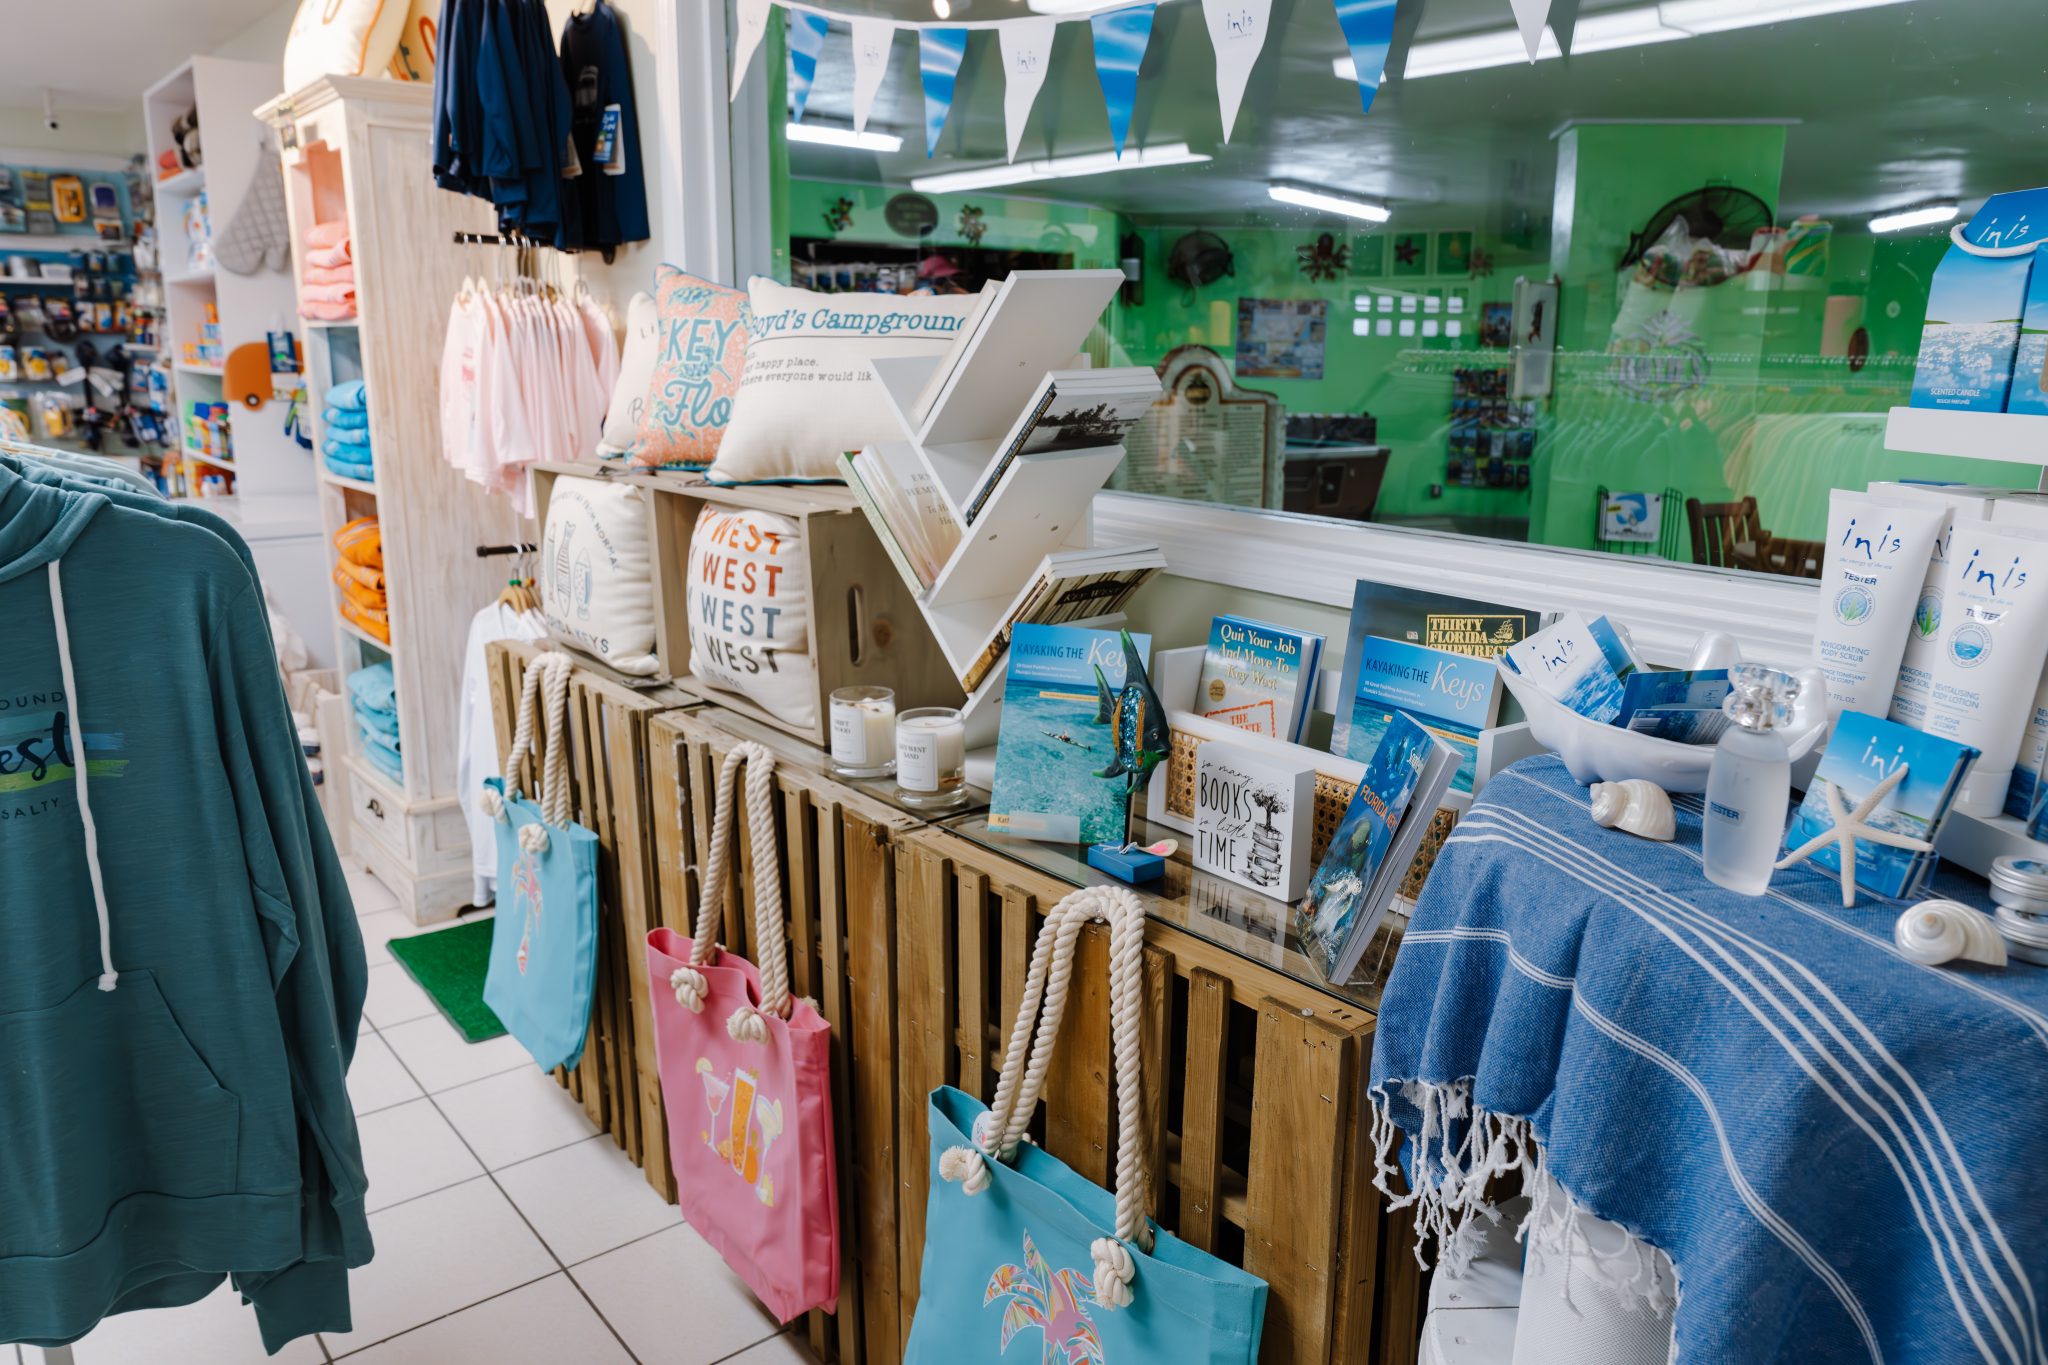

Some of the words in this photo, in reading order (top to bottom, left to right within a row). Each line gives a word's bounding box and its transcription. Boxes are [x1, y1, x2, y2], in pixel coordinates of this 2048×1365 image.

[1227, 9, 1253, 34] inis
[1976, 214, 2030, 249] inis
[750, 308, 807, 338] oyd's
[667, 318, 739, 362] KEY
[765, 371, 814, 384] everyone
[818, 371, 854, 382] would
[1930, 387, 1956, 396] SCENTED
[1956, 388, 1981, 397] CANDLE
[664, 377, 732, 428] Flo
[711, 516, 782, 556] WEST
[1842, 518, 1901, 560] inis
[703, 551, 784, 598] WEST
[1844, 571, 1878, 586] TESTER
[1962, 548, 2027, 596] inis
[701, 591, 782, 640] WEST
[1430, 618, 1484, 632] THIRTY
[704, 631, 780, 675] WEST
[1221, 624, 1244, 643] Quit
[1248, 629, 1273, 649] Your
[1274, 637, 1296, 655] Job
[1429, 631, 1489, 645] FLORIDA
[1820, 640, 1871, 656] INVIGORATING
[1017, 642, 1064, 659] KAYAKING
[1065, 647, 1084, 660] THE
[1087, 637, 1128, 679] Key
[1219, 643, 1241, 660] And
[1241, 648, 1273, 669] Move
[1276, 656, 1290, 673] To
[1542, 638, 1574, 673] inis
[1821, 647, 1838, 657] BODY
[1840, 651, 1864, 663] SCRUB
[1226, 663, 1249, 686] Key
[1252, 669, 1278, 691] West
[1365, 657, 1410, 679] KAYAKING
[1411, 668, 1430, 685] THE
[1430, 660, 1485, 711] Keys
[1949, 694, 1980, 710] LOTION
[1230, 712, 1248, 725] THE
[1202, 760, 1213, 769] so
[1861, 735, 1905, 780] ini
[1, 796, 60, 821] SALTY
[1200, 772, 1252, 823] BOOKS
[1360, 784, 1389, 820] FLORIDA
[1199, 817, 1211, 826] so
[1216, 816, 1249, 839] little
[1198, 829, 1236, 874] TIME
